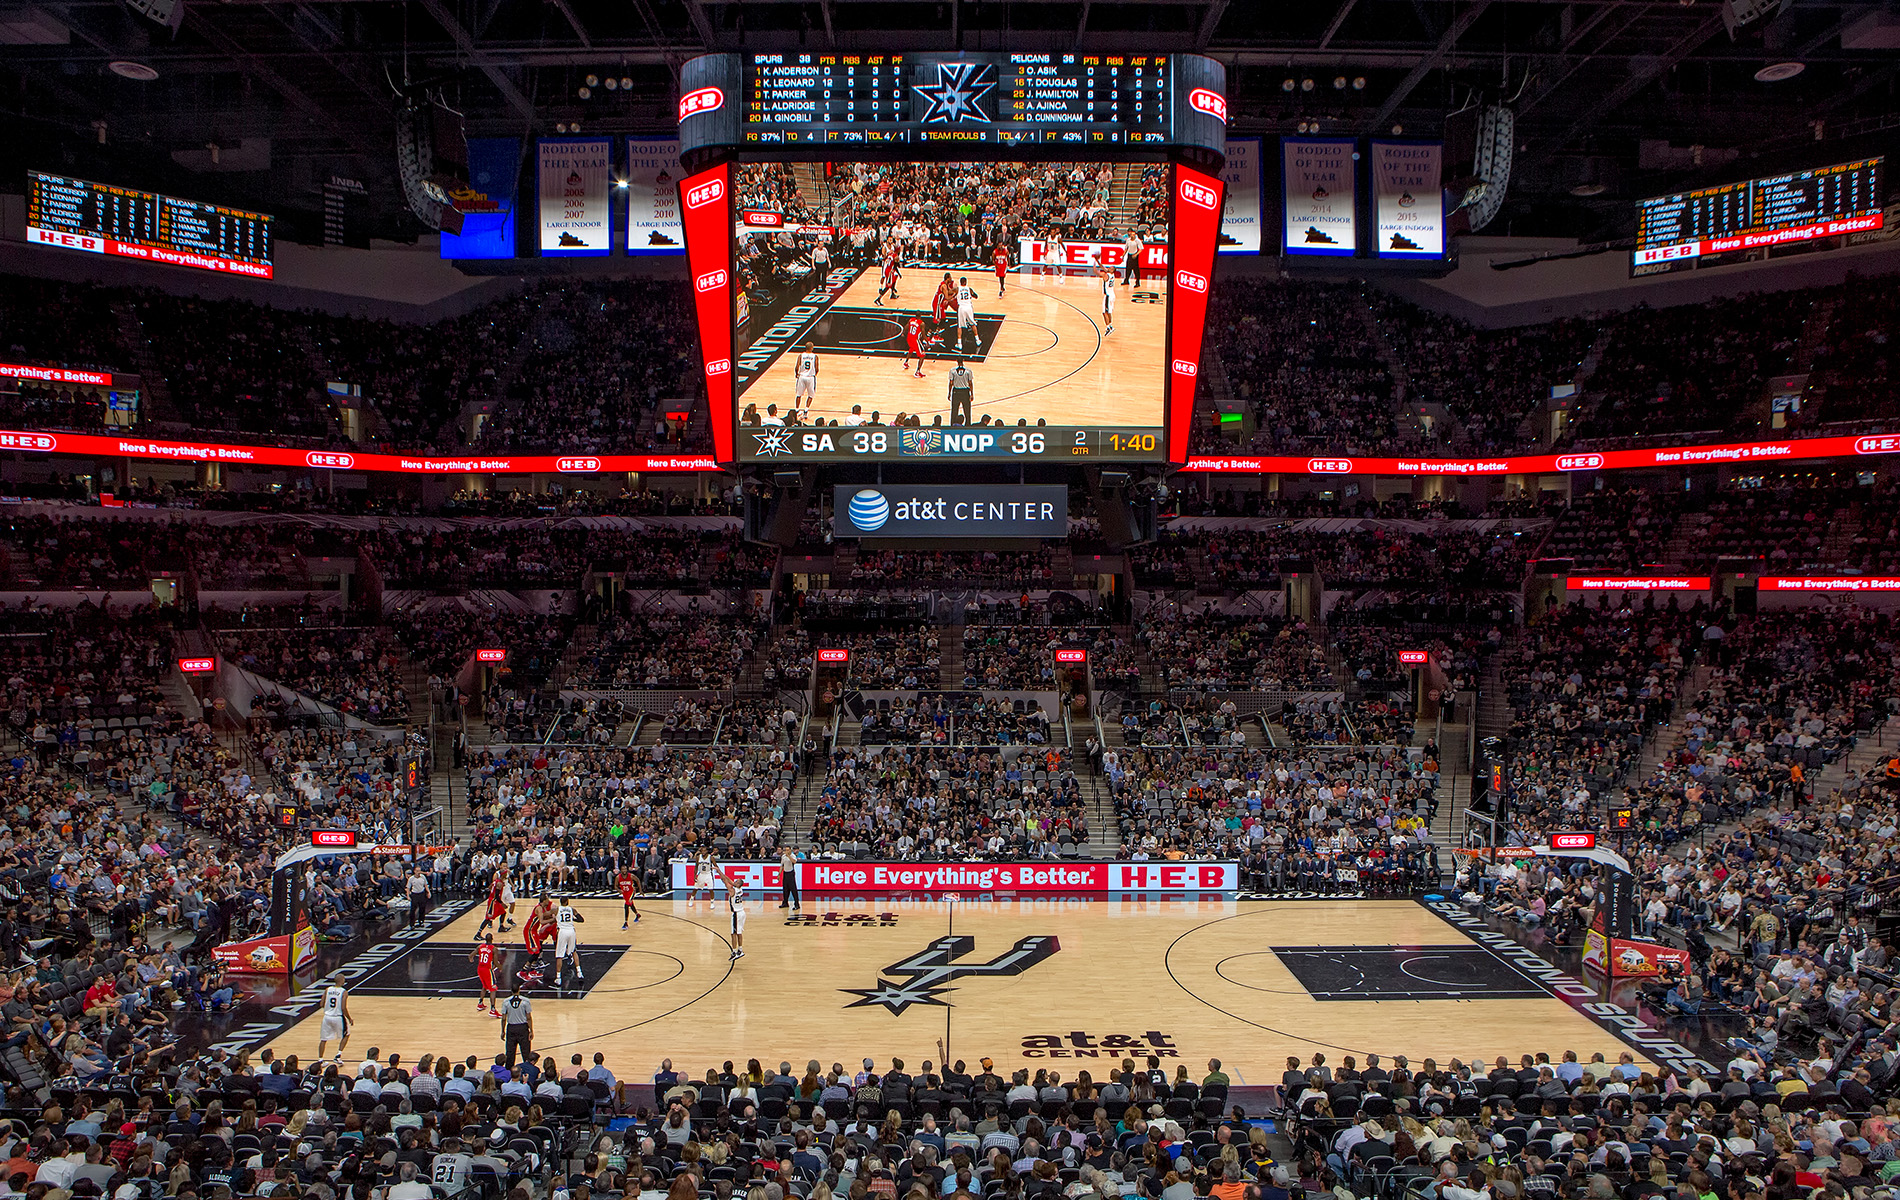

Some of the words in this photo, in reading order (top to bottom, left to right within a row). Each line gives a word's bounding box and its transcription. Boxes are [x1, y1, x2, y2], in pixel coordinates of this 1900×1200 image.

[755, 55, 782, 64] SPURS
[799, 55, 810, 64] 38
[1011, 55, 1050, 64] PELICANS
[1083, 57, 1099, 65] PTS
[1107, 57, 1123, 65] RBS
[1131, 57, 1147, 66] AST
[773, 67, 819, 75] ANDERSON
[1037, 67, 1057, 75] ASIK
[774, 79, 815, 87] LEONARD
[1036, 78, 1077, 87] DOUGLAS
[772, 90, 806, 99] PARKER
[1013, 90, 1024, 99] 25
[1036, 90, 1078, 99] HAMILTON
[751, 102, 761, 110] 12
[772, 102, 815, 110] ALDRIDGE
[1036, 102, 1067, 110] AJINCA
[774, 114, 812, 122] GINOBILI
[1036, 114, 1082, 122] CUNNINGHAM
[747, 133, 758, 141] FG
[761, 133, 780, 141] 37%
[829, 132, 838, 140] FT
[844, 133, 862, 141] 73%
[1047, 132, 1056, 140] FT
[1063, 132, 1081, 141] 43%
[1131, 132, 1141, 141] FG
[1145, 133, 1164, 141] 37%
[542, 145, 586, 154] RODEO
[591, 144, 607, 153] OF
[631, 145, 676, 154] RODEO
[1385, 149, 1429, 158] RODEO
[543, 160, 569, 168] THE
[573, 159, 606, 168] YEAR
[633, 159, 659, 168] THE
[1317, 160, 1343, 168] THE
[1405, 164, 1430, 172] THE
[1304, 173, 1336, 181] YEAR
[1390, 176, 1423, 185] YEAR
[564, 188, 584, 197] 2005
[654, 188, 674, 196] 2008
[654, 199, 674, 208] 2009
[1311, 205, 1331, 213] 2014
[1712, 238, 1741, 250] Here
[1744, 225, 1824, 246] Everything's
[1828, 217, 1875, 233] Better.
[117, 243, 148, 257] Here
[151, 249, 226, 270] Everything's
[229, 262, 268, 277] Better.
[0, 365, 61, 380] erything's
[64, 371, 103, 384] Better.
[802, 434, 836, 452] SA
[853, 432, 888, 453] 38
[943, 434, 994, 452] NOP
[1011, 432, 1045, 454] 36
[1075, 432, 1086, 445] 2
[1109, 434, 1156, 451] 1:40
[119, 442, 146, 453] Here
[149, 444, 216, 458] Everything's
[218, 447, 254, 459] Better.
[1072, 447, 1089, 455] QTR
[1656, 451, 1681, 462] Here
[1682, 447, 1750, 460] Everything's
[1752, 445, 1791, 456] Better.
[401, 459, 422, 469] Here
[424, 460, 478, 471] Everything's
[480, 460, 509, 469] Better.
[1398, 462, 1419, 471] Here
[1420, 462, 1474, 472] Everything's
[1476, 462, 1508, 471] Better.
[895, 497, 947, 520] at&t
[954, 502, 1054, 520] CENTER
[1583, 579, 1602, 588] Here
[1604, 579, 1657, 589] Everything's
[1659, 579, 1690, 588] Better.
[1778, 579, 1801, 588] Here
[1802, 579, 1868, 590] Everything's
[1871, 580, 1900, 588] Bette
[815, 867, 869, 885] Here
[874, 866, 1012, 888] Everything's
[1020, 867, 1095, 885] Better.
[1228, 890, 1366, 899] FanDuel
[560, 913, 571, 922] 12
[786, 912, 899, 921] at&t
[479, 952, 489, 963] 16
[1429, 901, 1488, 927] SAN
[1469, 930, 1599, 997] ANTONIO
[1582, 1002, 1722, 1076] SPURS
[330, 998, 336, 1008] 9
[1021, 1031, 1176, 1048] at&t
[1022, 1050, 1181, 1058] CENTER
[435, 1165, 457, 1183] 21
